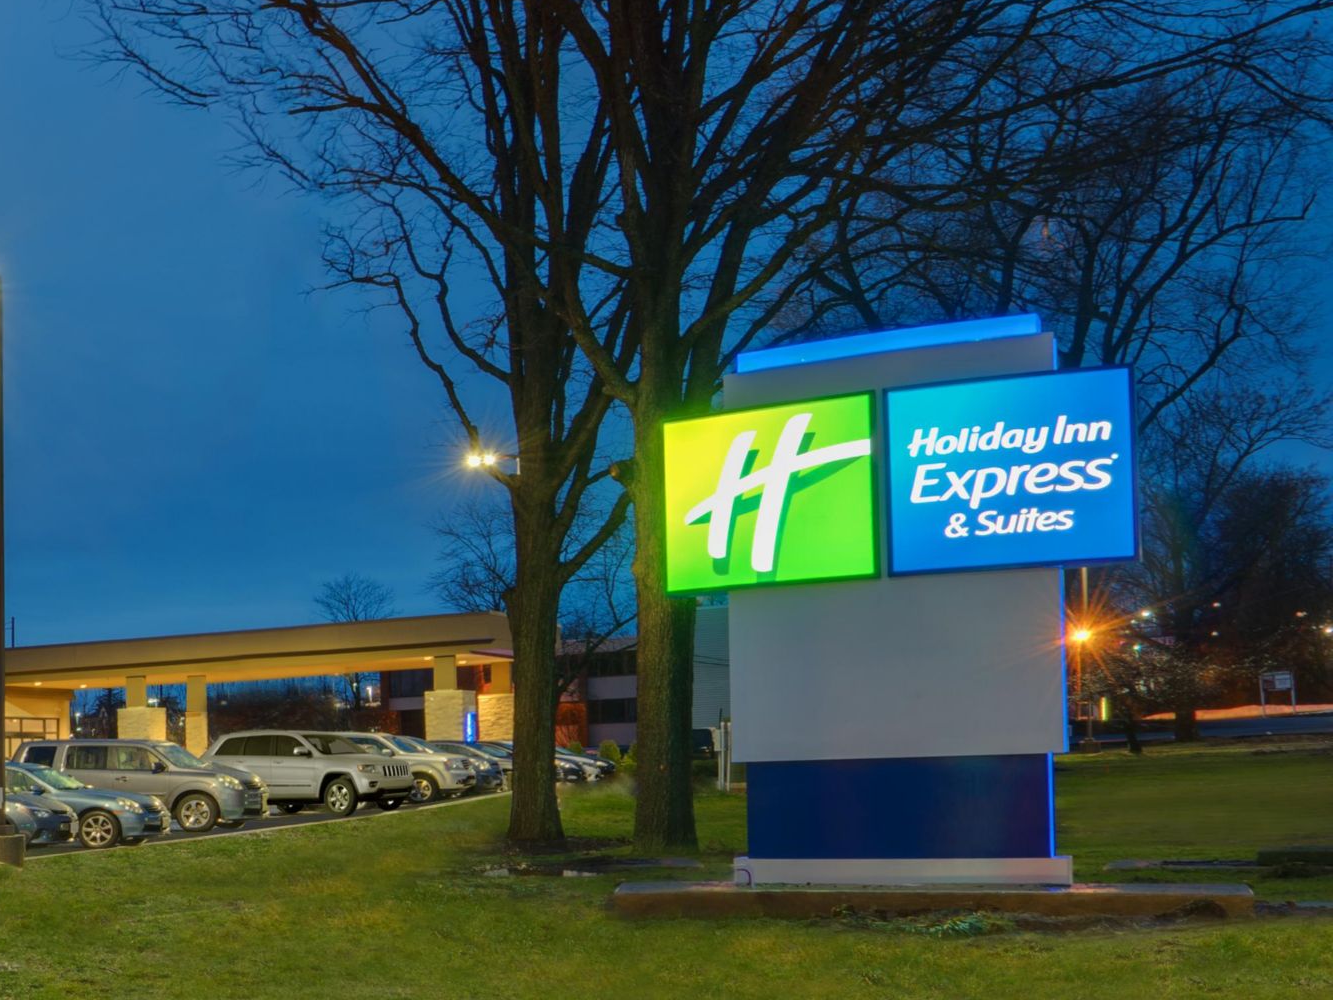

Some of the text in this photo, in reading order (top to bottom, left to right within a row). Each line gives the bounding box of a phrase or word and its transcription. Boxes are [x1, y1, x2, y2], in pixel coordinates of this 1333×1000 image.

[907, 414, 1113, 458] Holiday Inn
[909, 457, 1113, 510] Express
[944, 507, 1075, 538] & Suites
